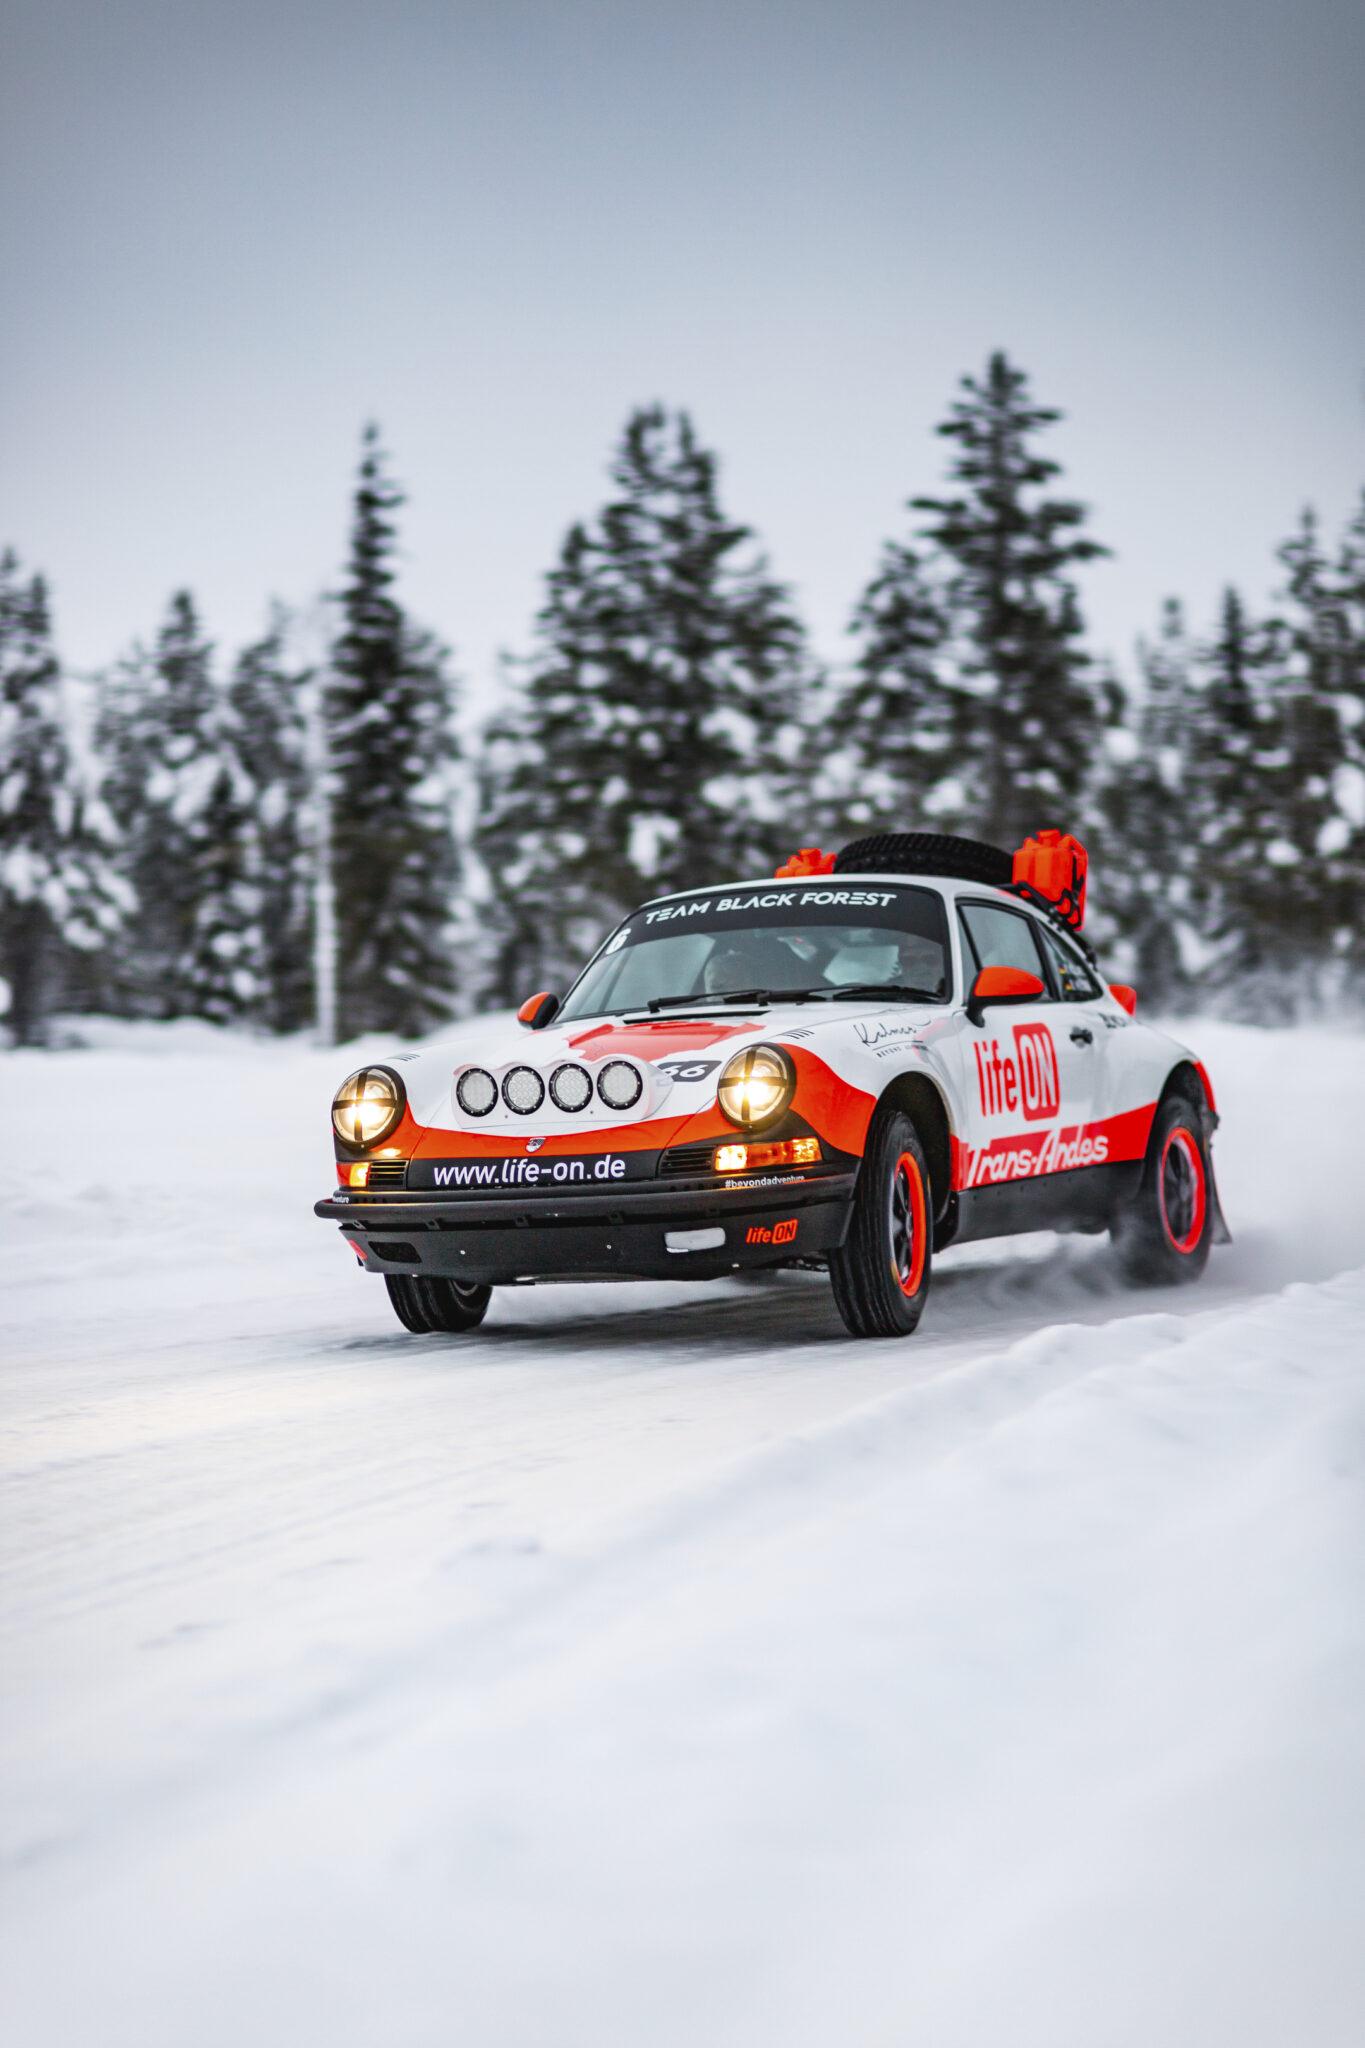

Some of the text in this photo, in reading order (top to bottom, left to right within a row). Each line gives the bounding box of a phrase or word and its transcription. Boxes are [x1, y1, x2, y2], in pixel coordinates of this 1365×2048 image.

[646, 891, 897, 925] TEAM BLACK FOREST
[433, 1155, 626, 1186] www.life-on.de
